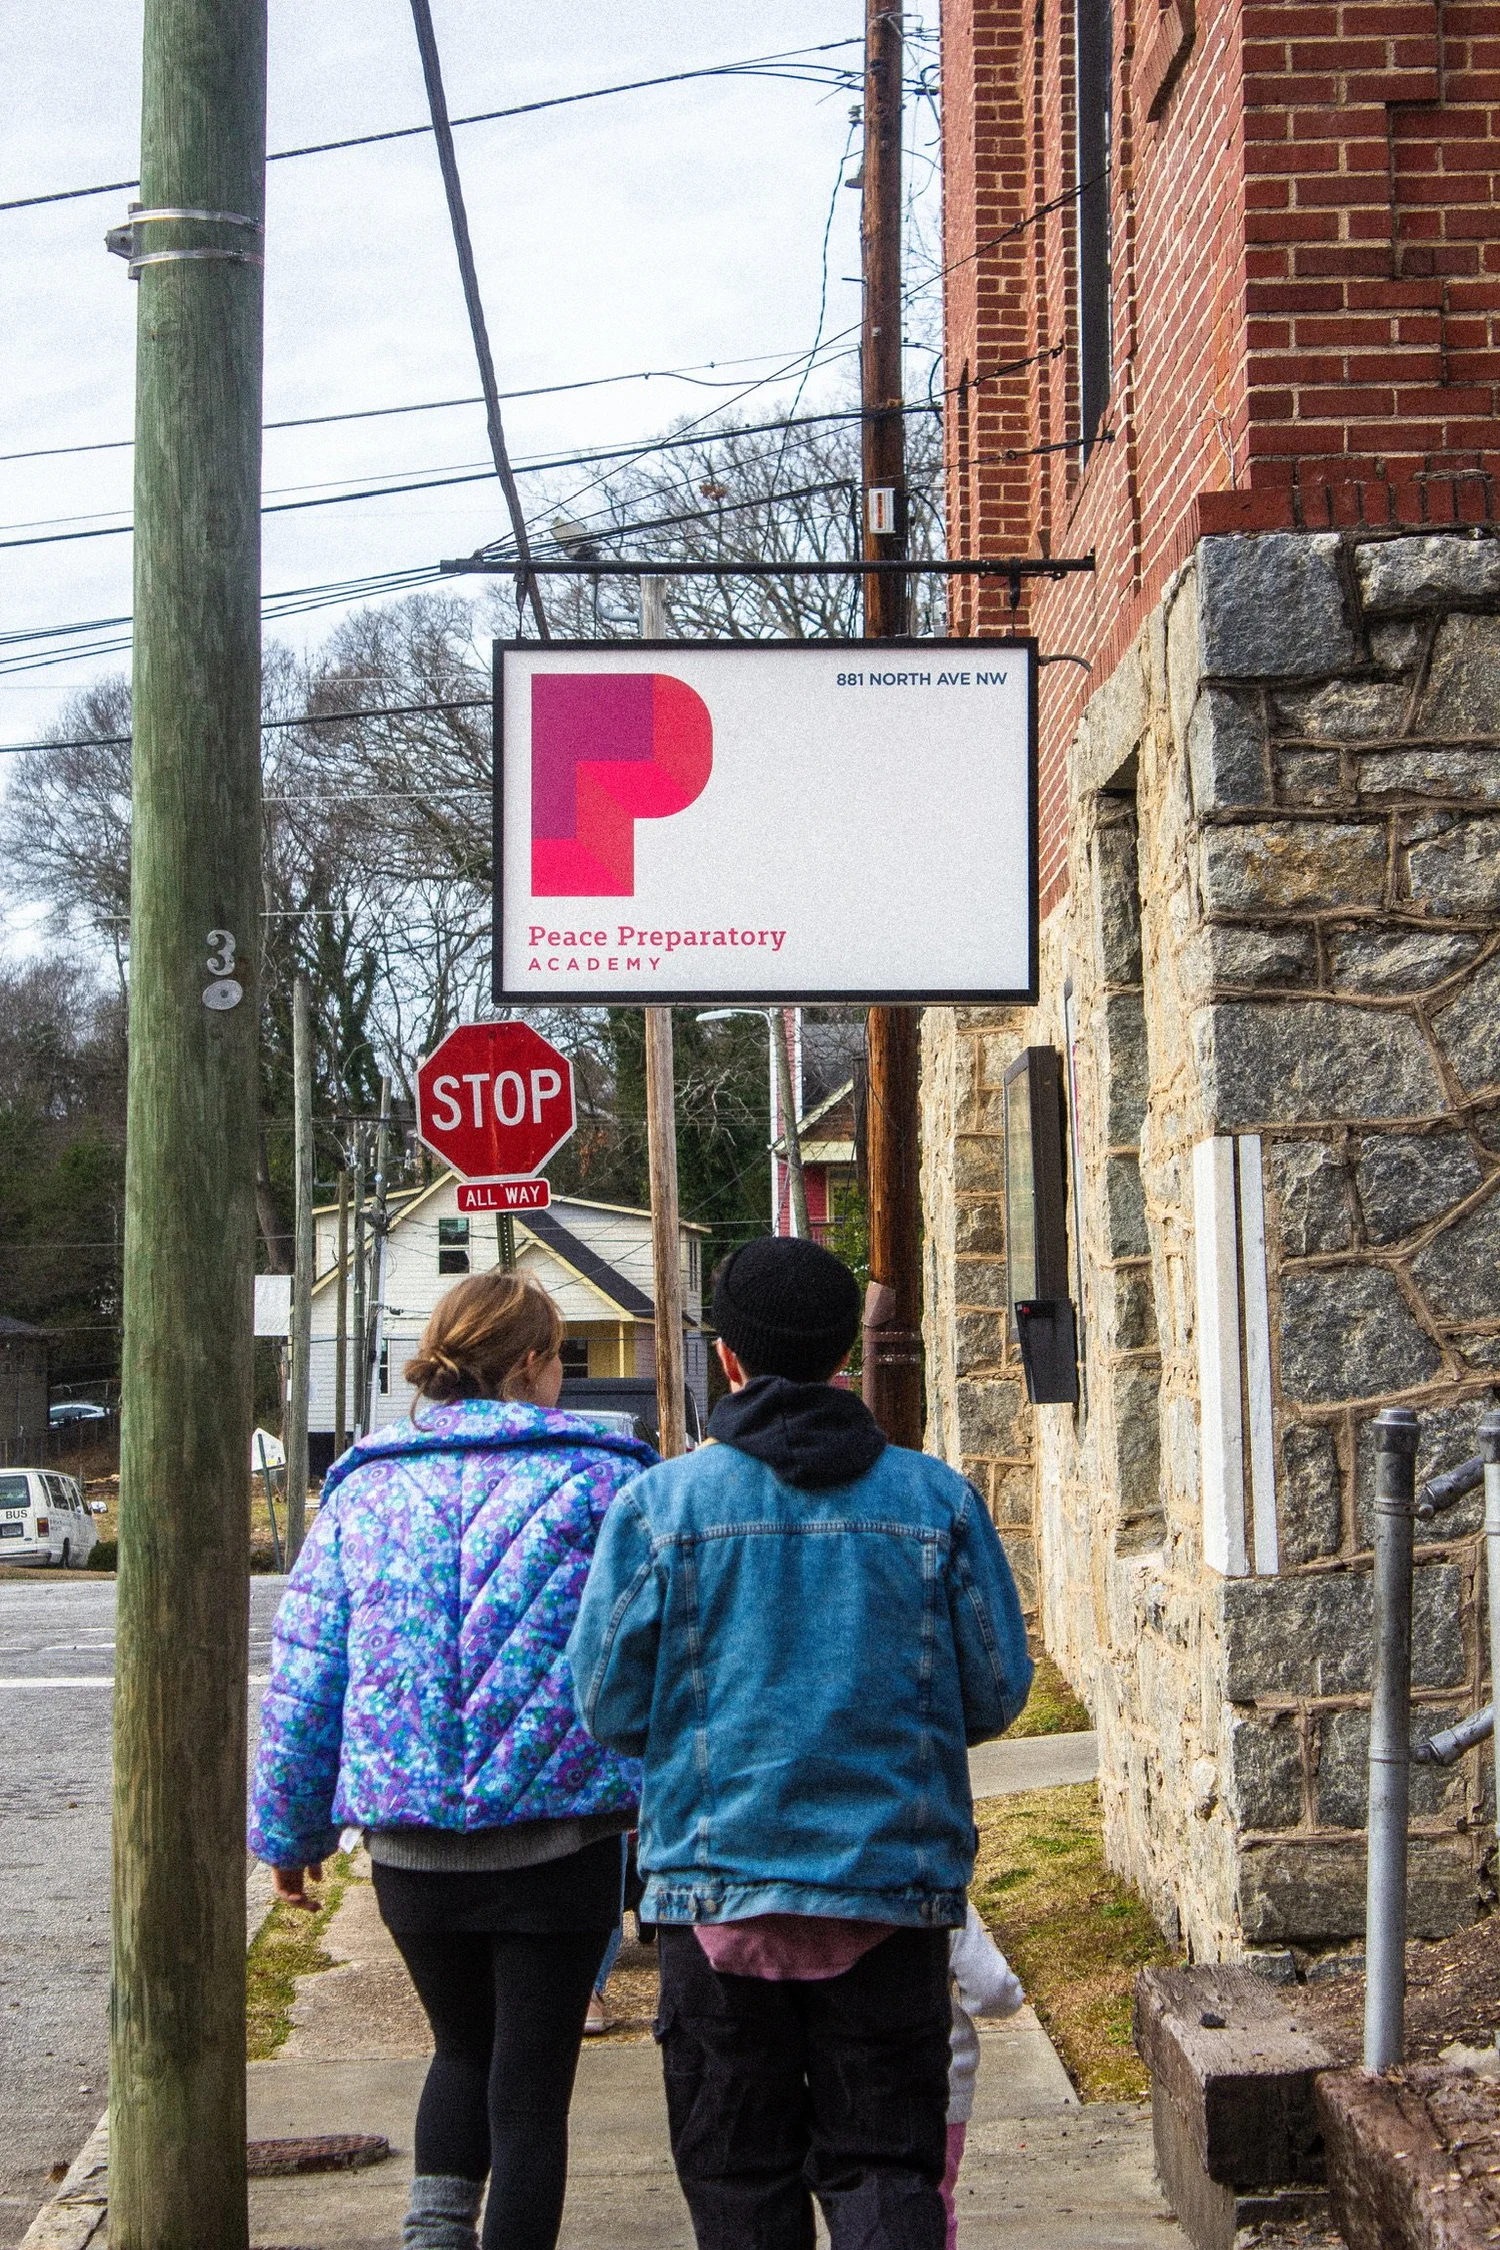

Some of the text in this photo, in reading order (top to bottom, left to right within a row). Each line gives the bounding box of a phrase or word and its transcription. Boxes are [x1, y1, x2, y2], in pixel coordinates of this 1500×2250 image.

[836, 672, 1008, 686] 881 NORTH AVE NW
[528, 925, 787, 951] Peace Preparatory
[206, 929, 236, 976] 3
[528, 957, 661, 971] ACADEMY
[431, 1068, 562, 1131] STOP
[465, 1185, 541, 1207] ALL WAY
[5, 1509, 28, 1520] BUS
